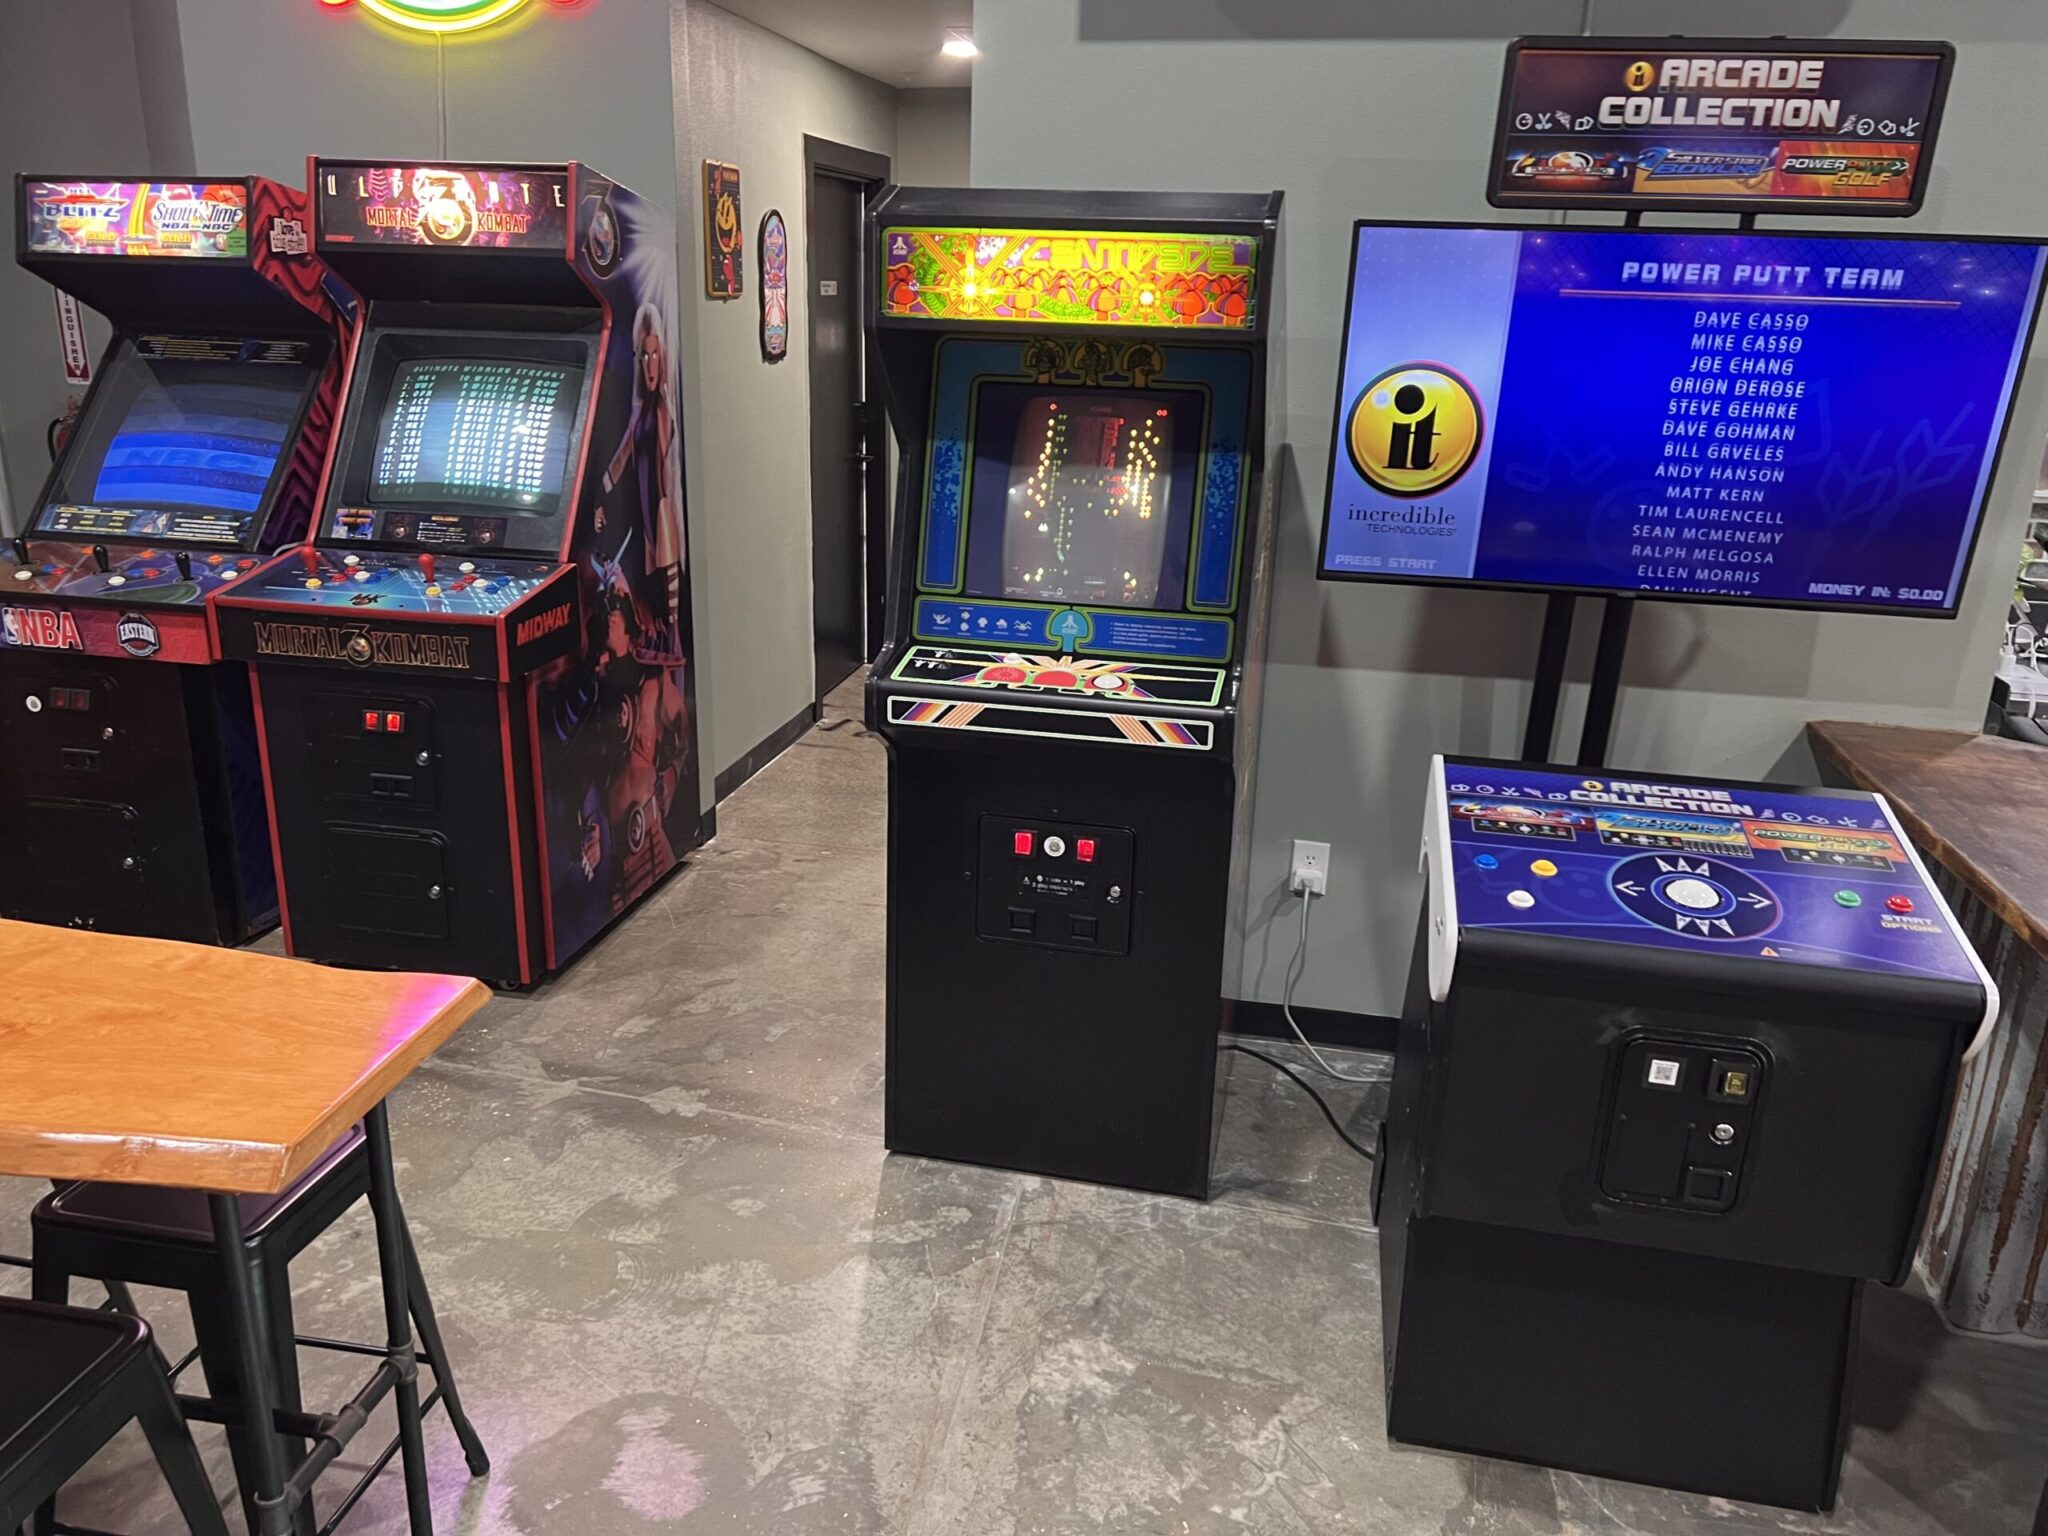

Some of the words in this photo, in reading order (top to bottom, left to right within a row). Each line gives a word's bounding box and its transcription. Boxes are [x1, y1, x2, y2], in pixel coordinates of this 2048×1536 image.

[1659, 58, 1825, 91] ARCADE
[1598, 95, 1840, 130] COLLECTION
[1653, 163, 1762, 176] BOWLING
[1834, 171, 1893, 186] GOLF
[161, 222, 190, 230] NBA
[366, 206, 419, 228] MORTAL
[477, 212, 528, 234] KOMBAT
[1021, 238, 1238, 273] CENTIPEDE
[1622, 262, 1721, 284] POWER
[1733, 265, 1811, 287] PUTT
[1824, 267, 1905, 289] TEAM
[1694, 311, 1742, 329] DAVE
[1748, 313, 1809, 331] CASSO
[1691, 334, 1736, 351] MIKE
[1742, 335, 1803, 353] CASSO
[463, 365, 511, 374] WINNING
[515, 368, 566, 380] STREAKS
[1689, 356, 1723, 373] JOE
[1729, 357, 1794, 375] CHANG
[472, 383, 500, 391] WINS
[533, 388, 558, 396] ROW
[474, 375, 502, 383] WINS
[535, 380, 560, 388] ROW
[1670, 377, 1728, 395] ORION
[1735, 379, 1806, 398] DEROSE
[467, 399, 495, 407] WINS
[528, 404, 554, 412] ROW
[469, 391, 497, 399] WINS
[531, 396, 556, 404] ROW
[465, 407, 494, 415] WINS
[527, 412, 553, 420] ROW
[1668, 398, 1721, 417] STEVE
[1728, 401, 1798, 420] GEHRKE
[464, 415, 492, 423] WINS
[526, 420, 550, 428] ROW
[1382, 384, 1442, 471] it
[1662, 419, 1708, 437] DAVE
[1714, 422, 1795, 441] GOHMAN
[459, 439, 487, 447] WINS
[520, 444, 546, 453] ROW
[1664, 441, 1699, 458] BILL
[456, 455, 485, 463] WINS
[518, 460, 544, 469] ROW
[454, 471, 482, 479] WINS
[486, 473, 500, 481] IN
[516, 477, 542, 486] ROW
[1655, 463, 1703, 479] ANDY
[1710, 465, 1784, 482] HANSON
[1666, 485, 1713, 500] MATT
[1719, 488, 1764, 503] KERN
[1347, 503, 1456, 526] incredible
[1638, 505, 1668, 518] TIM
[1675, 507, 1785, 525] LAURENCELL
[1632, 525, 1676, 538] SEAN
[1682, 528, 1784, 545] MCMENEMY
[1334, 554, 1382, 567] PRESS
[1388, 557, 1437, 570] START
[1632, 544, 1687, 559] RALPH
[1692, 548, 1774, 564] MELGOSA
[1637, 565, 1688, 579] ELLEN
[1695, 569, 1760, 584] MORRIS
[1808, 583, 1866, 596] MONEY
[21, 609, 84, 650] NBA
[516, 602, 571, 647] MIDWAY
[253, 622, 348, 660] MORTAL
[371, 631, 470, 669] KOMBAT
[1610, 782, 1732, 802] ARCADE
[1570, 790, 1754, 816] COLLECTION
[1754, 829, 1824, 842] POWER
[1880, 921, 1943, 934] OPTIONS
[1881, 914, 1933, 926] START
